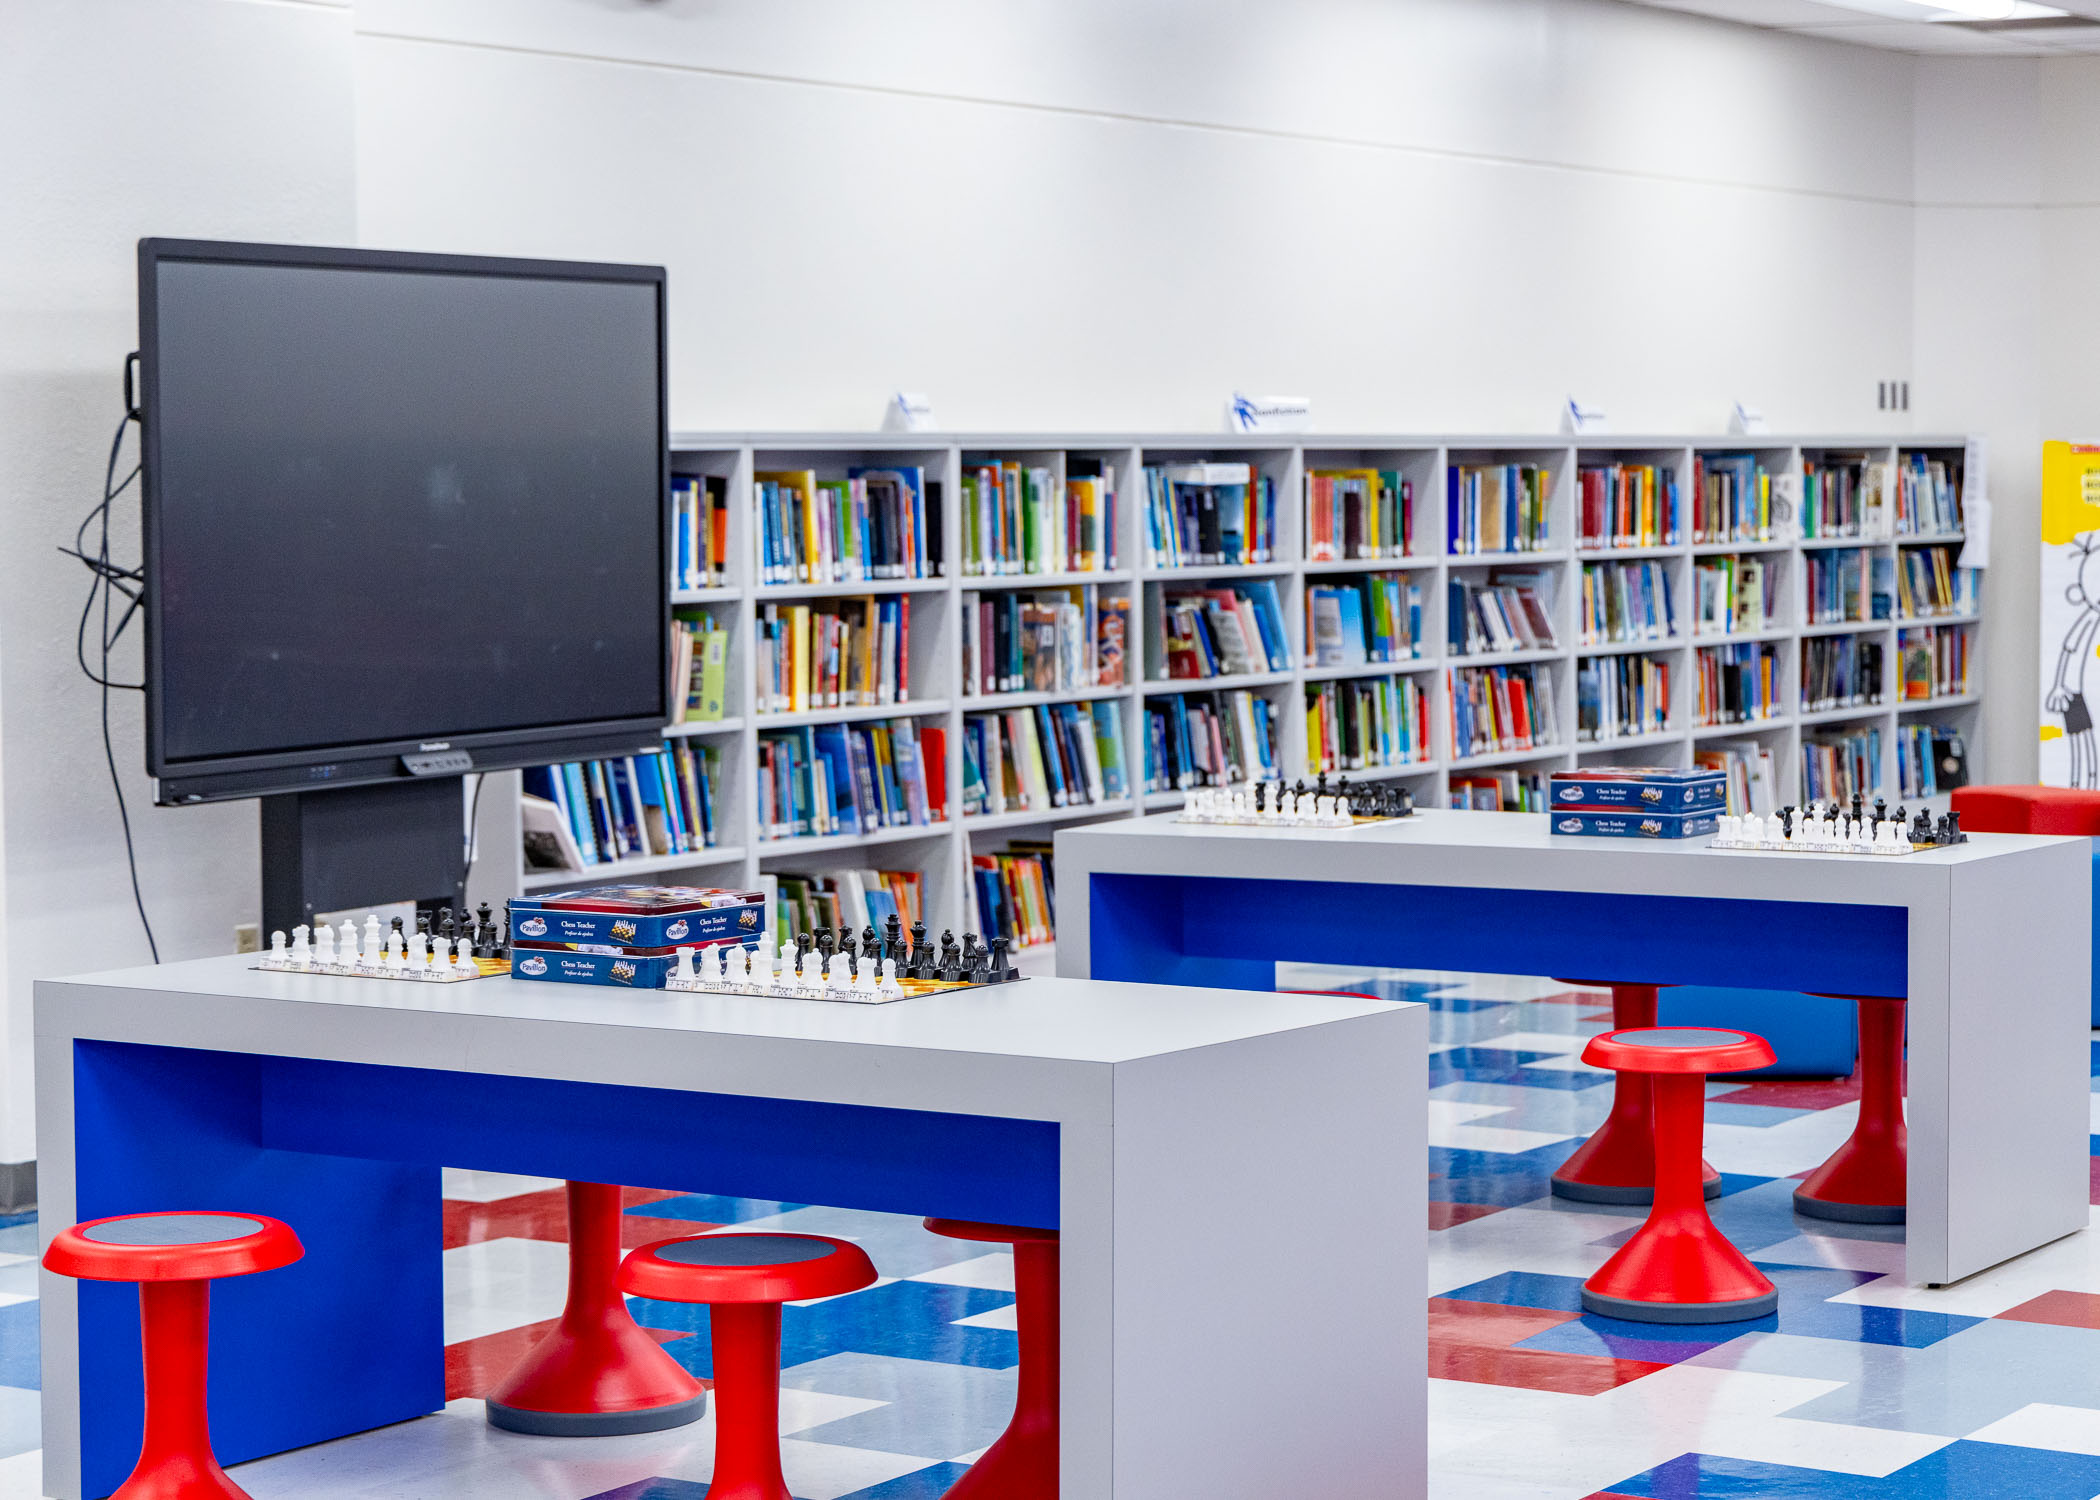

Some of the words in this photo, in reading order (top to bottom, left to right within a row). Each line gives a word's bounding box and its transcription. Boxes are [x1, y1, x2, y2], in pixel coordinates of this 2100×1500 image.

[576, 921, 596, 929] Teacher
[700, 918, 711, 926] Chess
[712, 916, 727, 924] Teacher
[522, 924, 546, 932] Pavilion
[668, 926, 688, 936] Pavilion
[522, 963, 546, 971] Pavilion
[561, 960, 576, 968] Chess
[576, 961, 596, 969] Teacher
